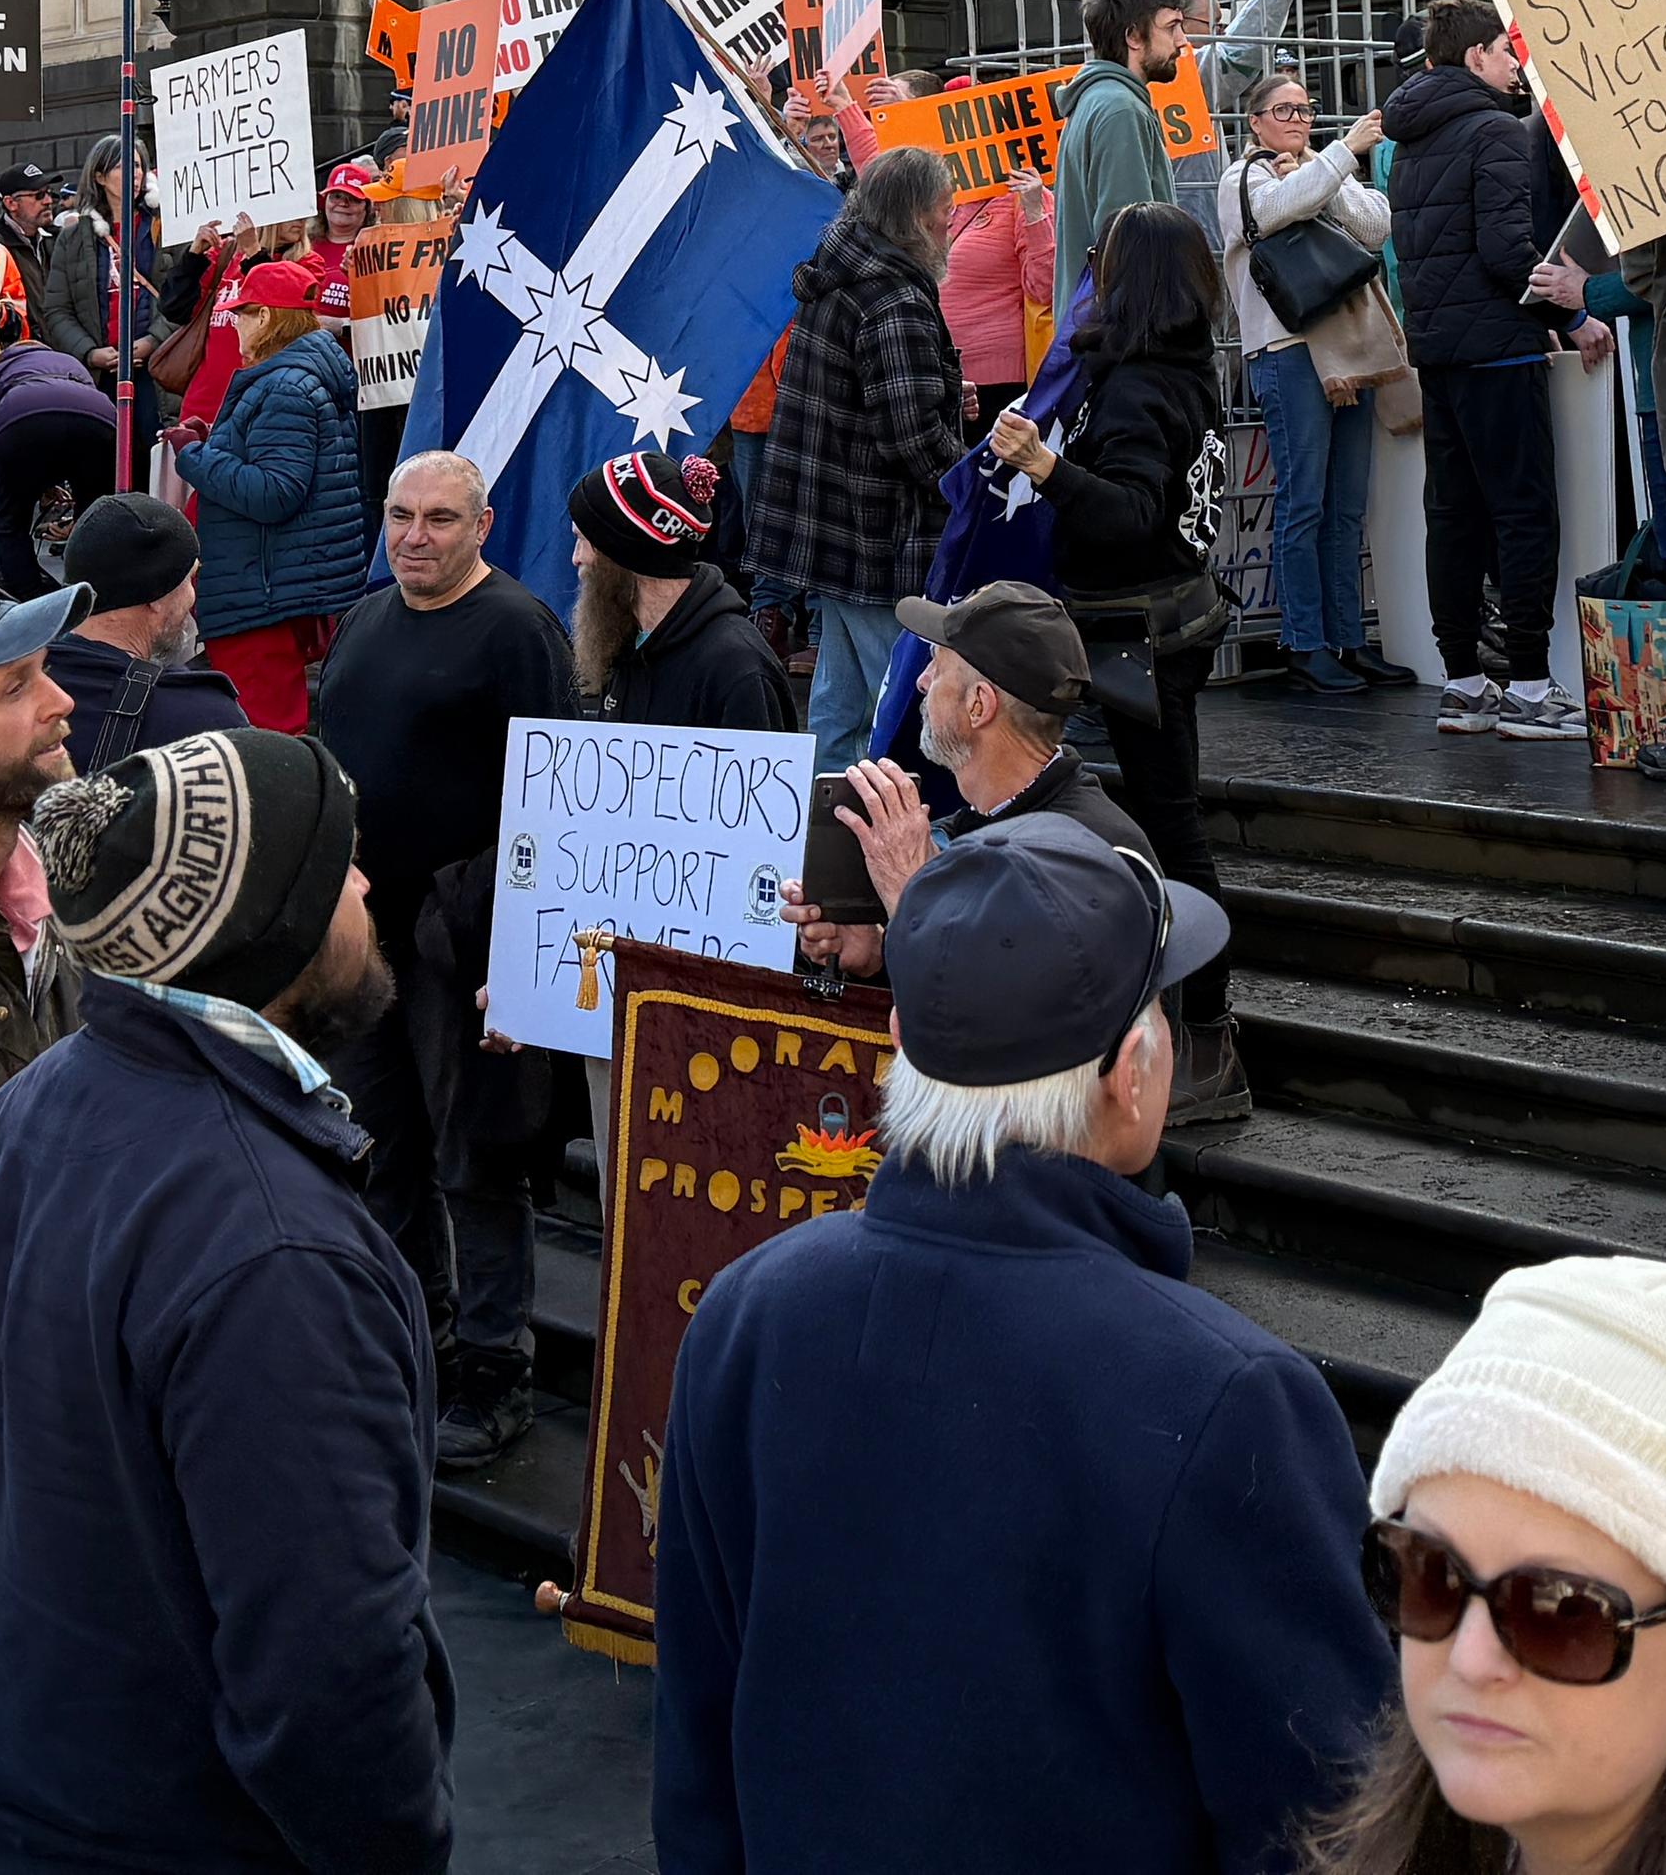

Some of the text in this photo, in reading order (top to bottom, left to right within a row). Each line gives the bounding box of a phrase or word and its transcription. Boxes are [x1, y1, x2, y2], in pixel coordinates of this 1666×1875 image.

[168, 44, 281, 115] FARMERS
[434, 23, 477, 83] NO
[495, 38, 531, 77] NO
[197, 97, 275, 152] LIVES
[411, 87, 488, 155] MINE
[936, 85, 1043, 145] MINE
[173, 139, 295, 218] MATTER
[944, 132, 1053, 192] ALLEE
[353, 235, 453, 279] MINE FR
[384, 294, 411, 326] NO
[521, 729, 802, 842] PROSPECTORS
[555, 829, 731, 917] SUPPORT
[639, 1157, 866, 1220] PROSPE
